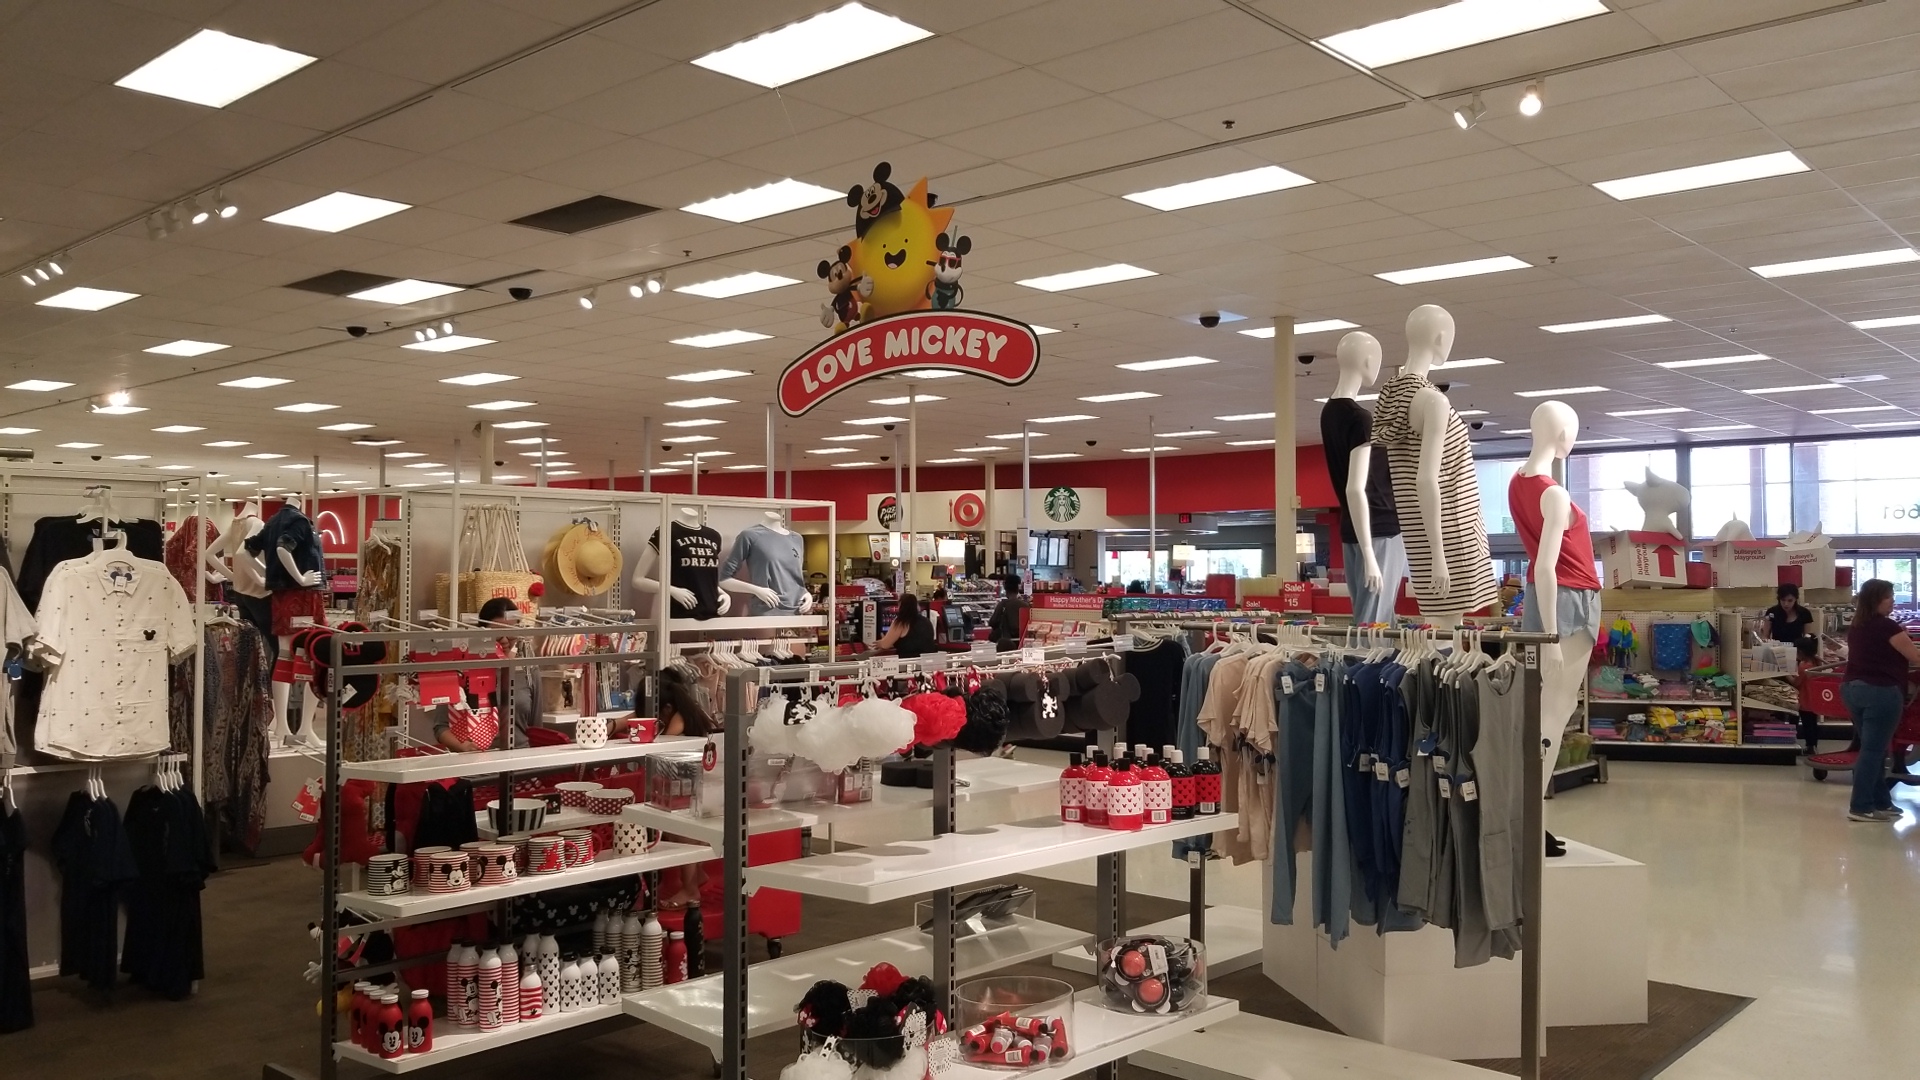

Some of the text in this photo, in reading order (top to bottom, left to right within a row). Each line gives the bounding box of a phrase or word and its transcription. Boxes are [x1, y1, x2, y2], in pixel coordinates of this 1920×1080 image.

[801, 325, 1008, 394] LOVE MICKEY
[881, 506, 896, 519] Pizz
[676, 536, 718, 550] LIVING
[689, 547, 714, 556] THE
[681, 557, 719, 567] DREA
[1641, 543, 1650, 576] playgroun
[1284, 583, 1306, 592] Sale!
[1245, 600, 1261, 608] Sale!
